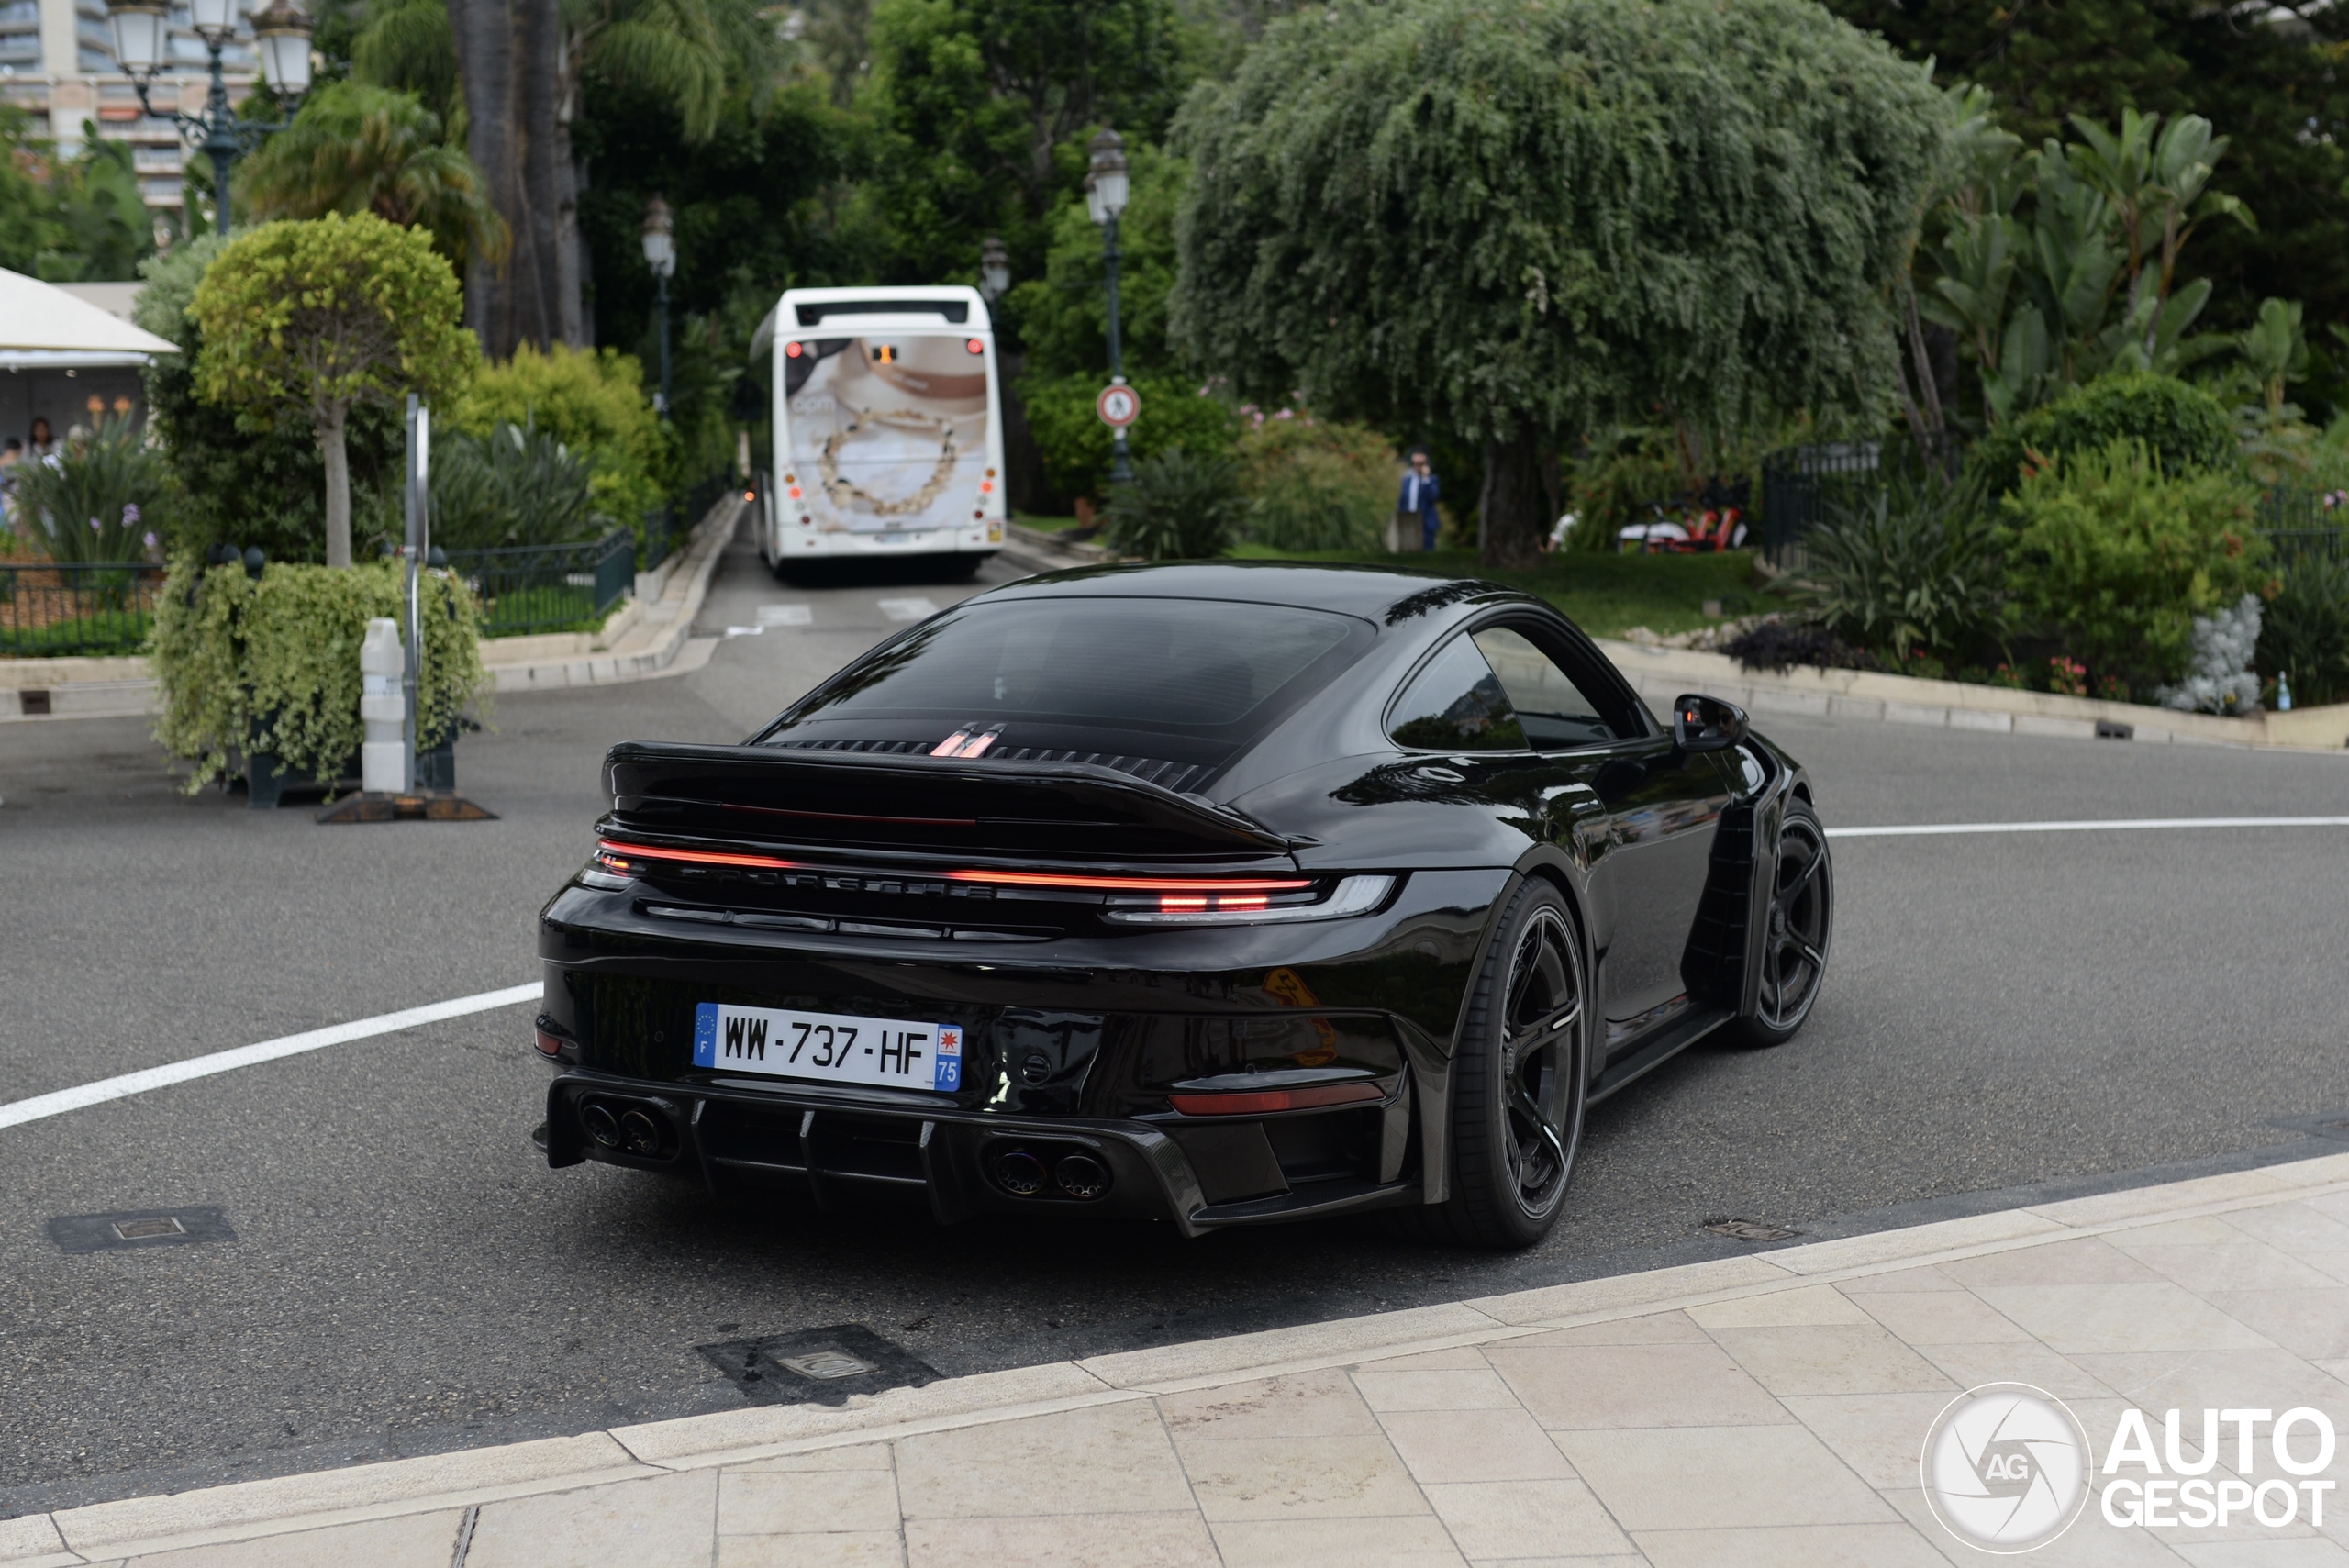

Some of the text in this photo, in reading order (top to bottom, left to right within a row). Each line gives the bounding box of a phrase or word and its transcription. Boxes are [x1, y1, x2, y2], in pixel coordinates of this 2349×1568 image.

[719, 870, 994, 900] PORSCHE
[699, 1040, 707, 1053] F
[725, 1016, 928, 1074] WW-737-HF
[938, 1061, 957, 1082] 75
